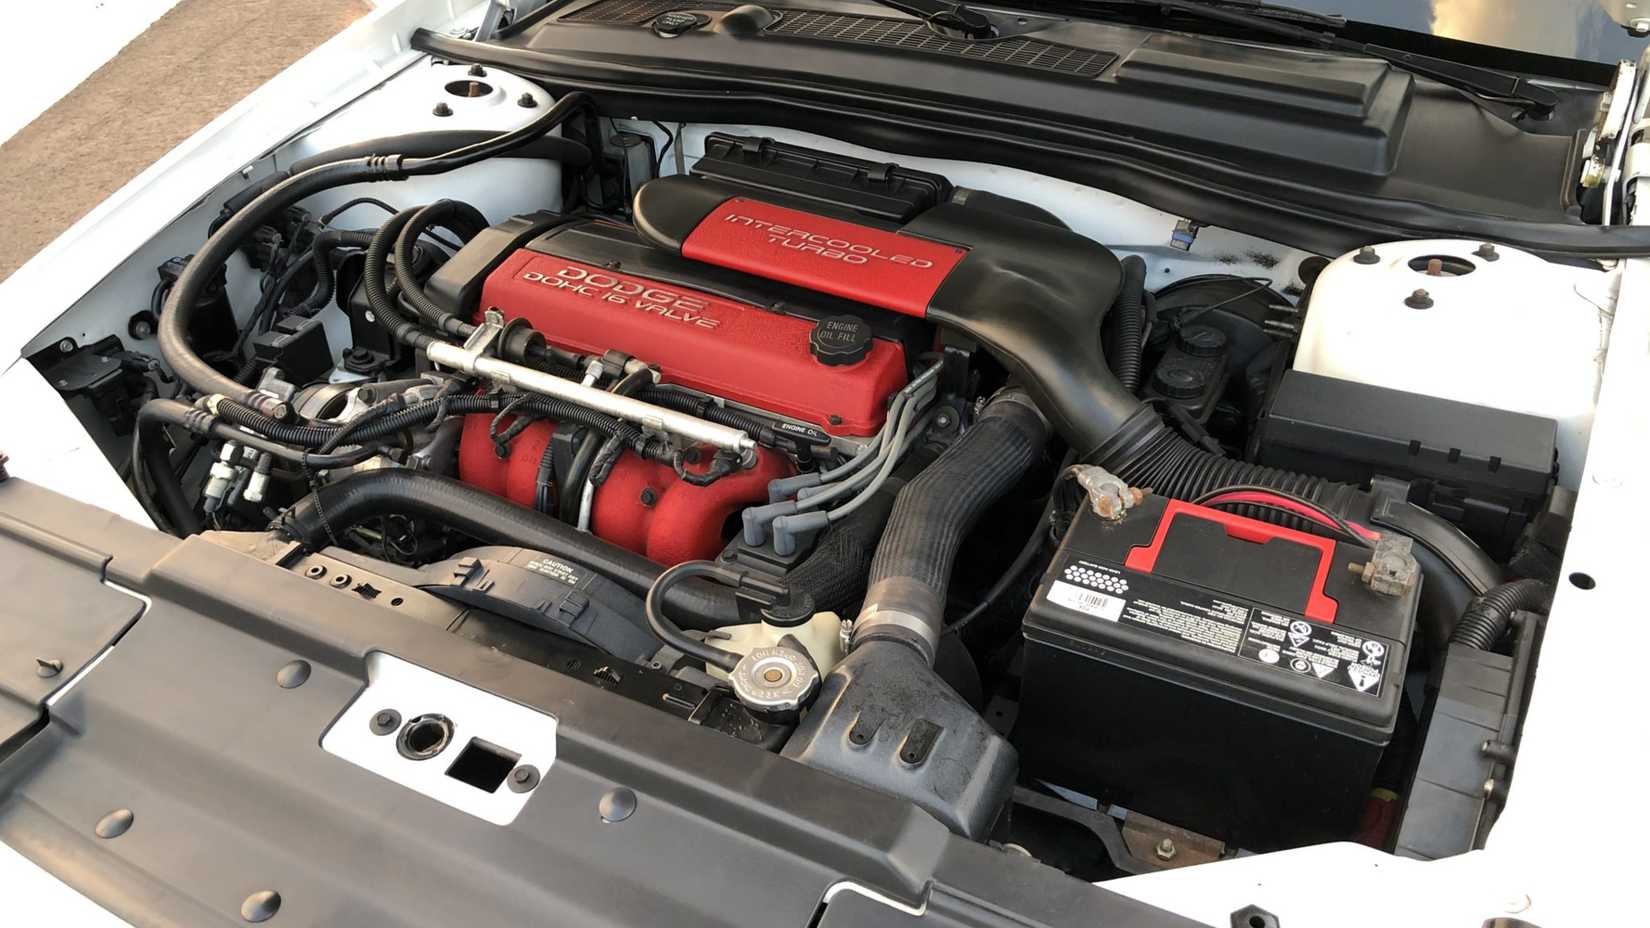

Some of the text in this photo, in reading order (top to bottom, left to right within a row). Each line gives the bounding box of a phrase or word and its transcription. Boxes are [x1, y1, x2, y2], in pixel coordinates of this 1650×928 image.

[723, 214, 934, 269] INTERCOOLED
[768, 234, 868, 265] TURBO
[557, 266, 710, 312] DODGE
[523, 272, 720, 329] DOHC 16 VALVE
[820, 330, 856, 342] OIL FILL
[826, 321, 859, 333] ENGINE
[782, 423, 806, 433] ENGINE
[543, 559, 574, 573] CAUTION
